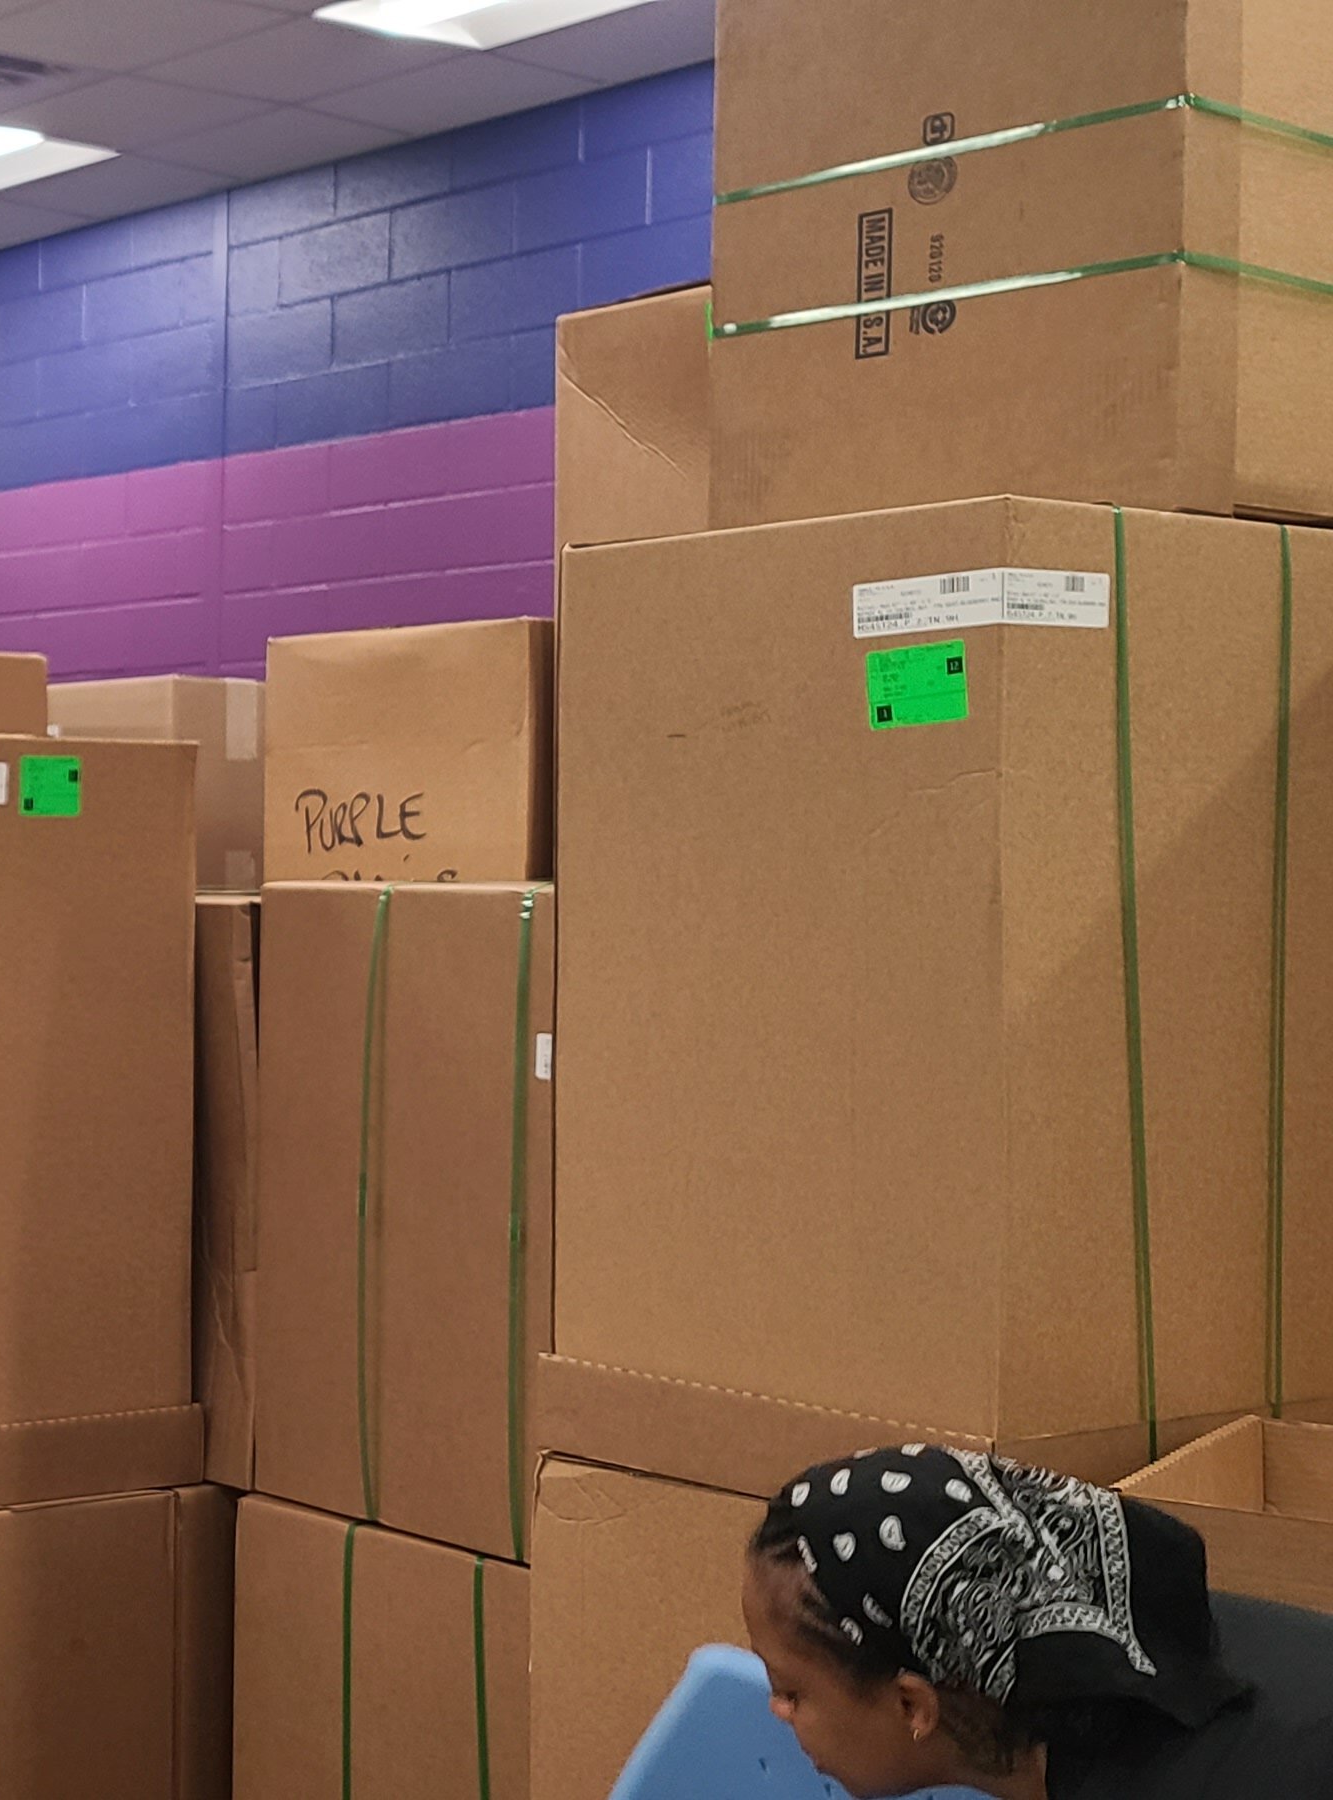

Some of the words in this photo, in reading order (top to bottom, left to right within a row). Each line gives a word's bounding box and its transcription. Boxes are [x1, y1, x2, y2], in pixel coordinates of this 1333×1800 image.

[864, 216, 886, 269] MADE
[864, 275, 885, 293] IN
[295, 788, 427, 854] PURPLE
